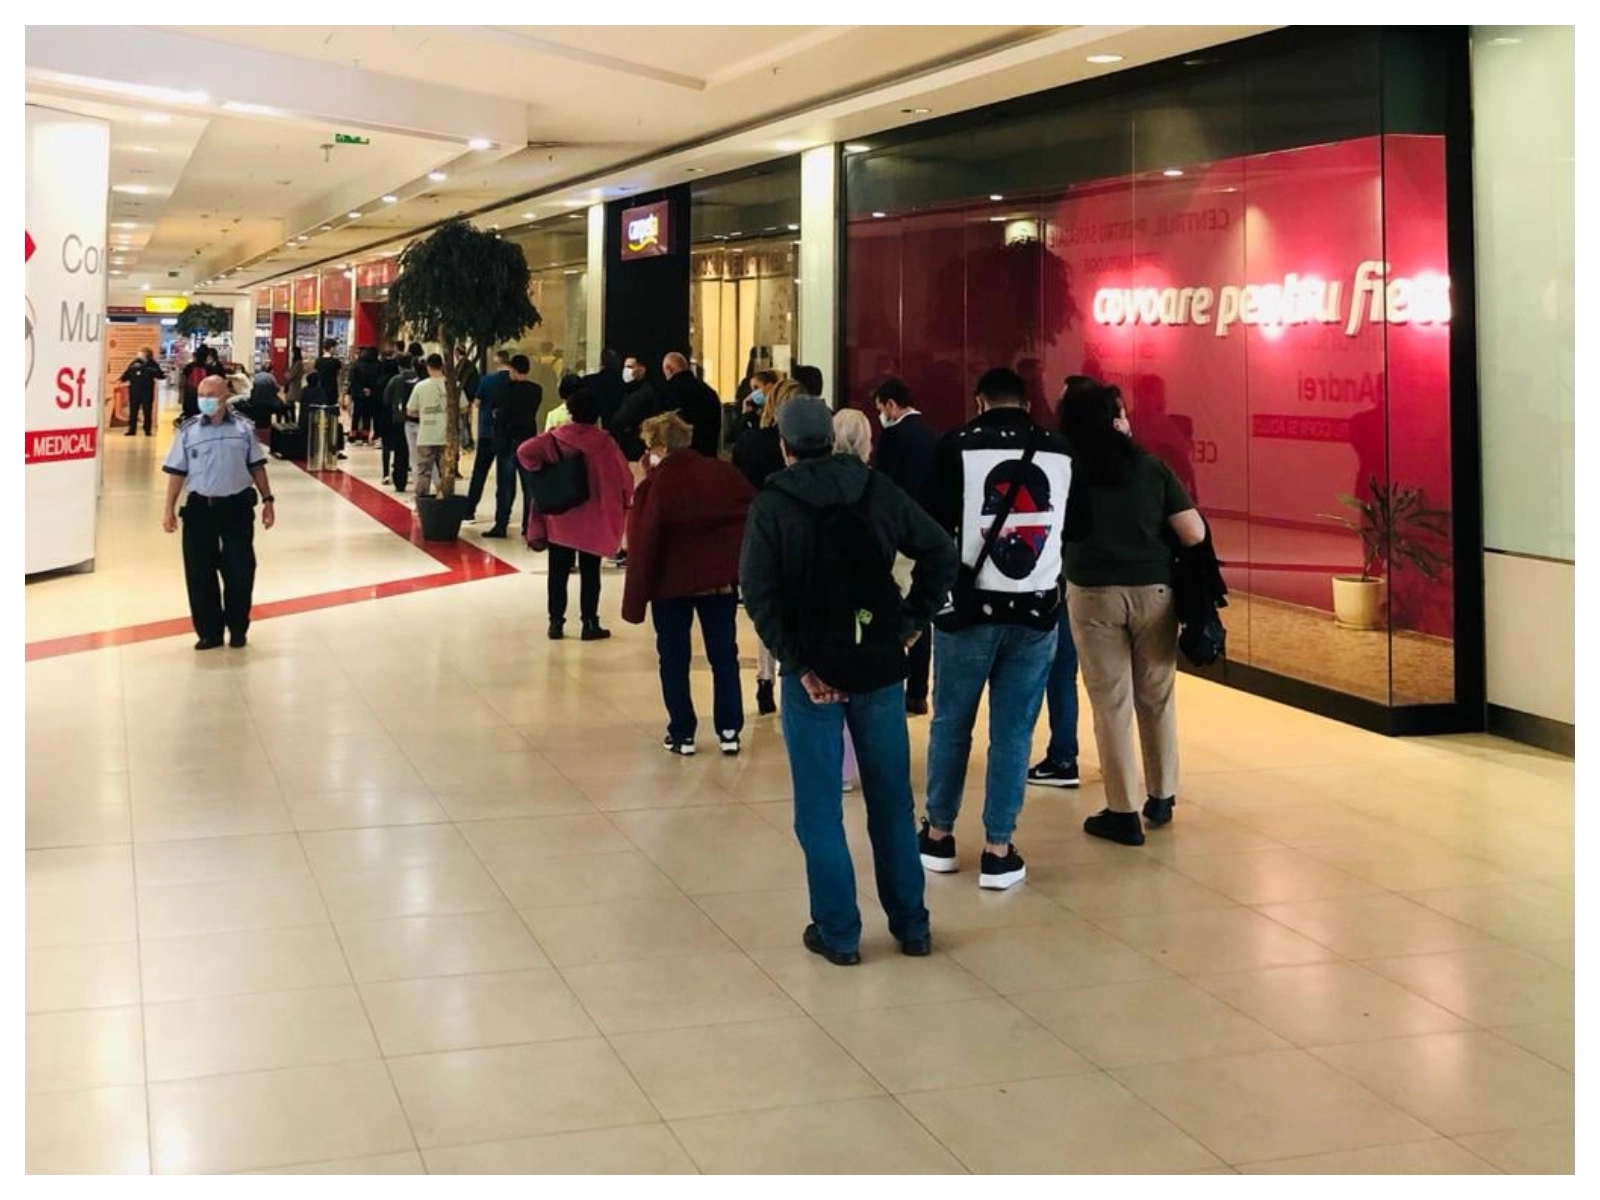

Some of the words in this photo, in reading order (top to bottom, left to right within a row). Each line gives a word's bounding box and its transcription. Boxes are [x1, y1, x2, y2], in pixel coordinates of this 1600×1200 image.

[1093, 286, 1214, 325] covoare
[55, 366, 91, 409] Sf.
[33, 433, 94, 458] MEDICAL
